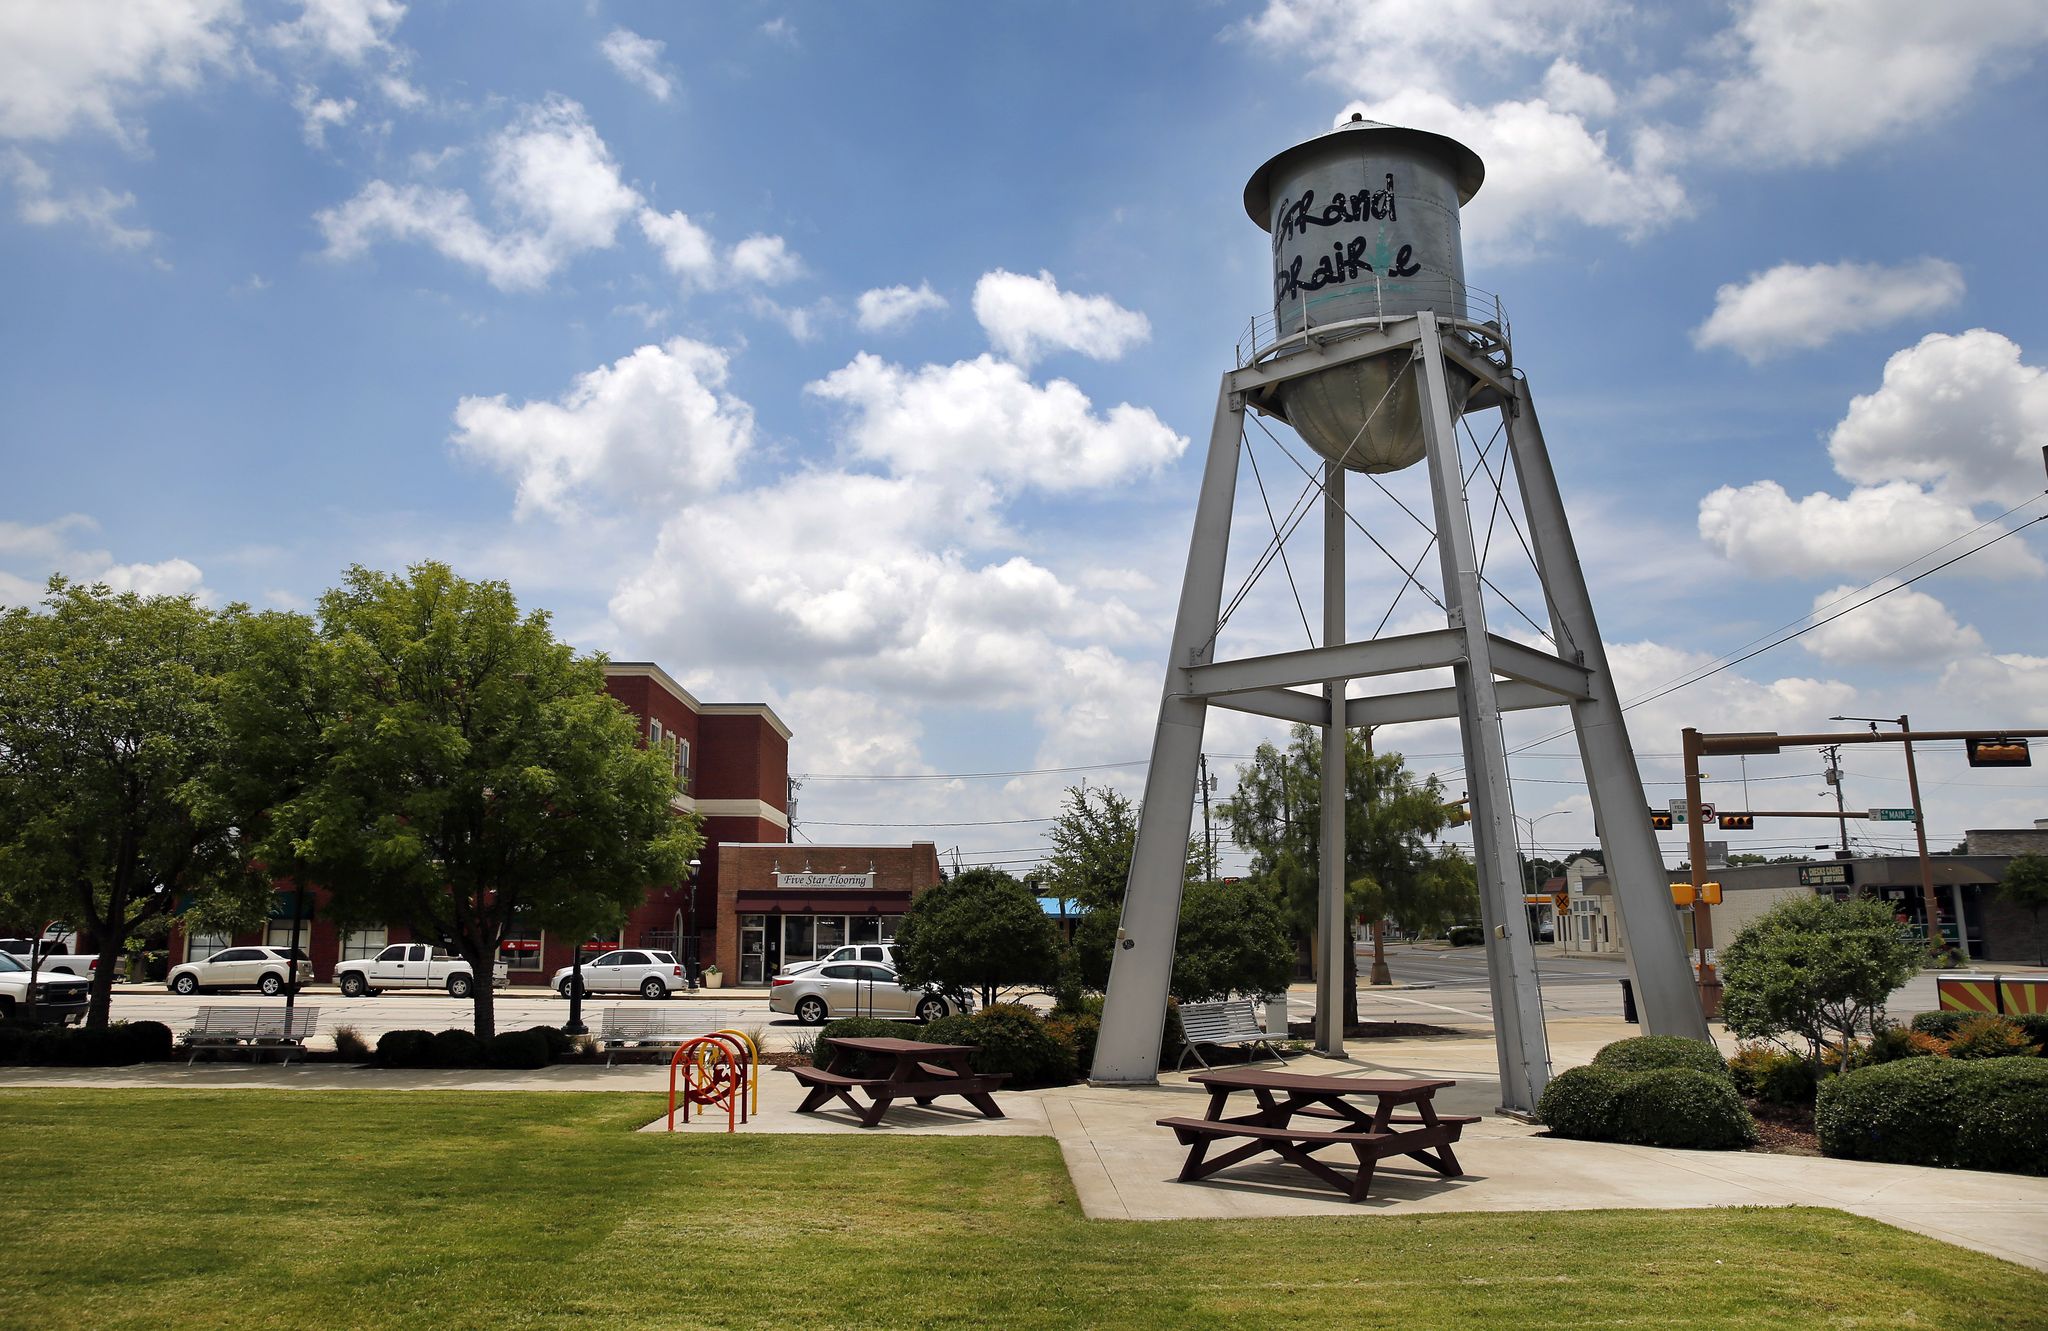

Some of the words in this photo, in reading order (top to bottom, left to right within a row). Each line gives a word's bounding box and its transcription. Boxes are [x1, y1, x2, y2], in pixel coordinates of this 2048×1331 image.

[1889, 810, 1906, 819] MAIN
[784, 875, 804, 884] Five
[806, 875, 828, 885] Star
[829, 875, 866, 887] Flooring
